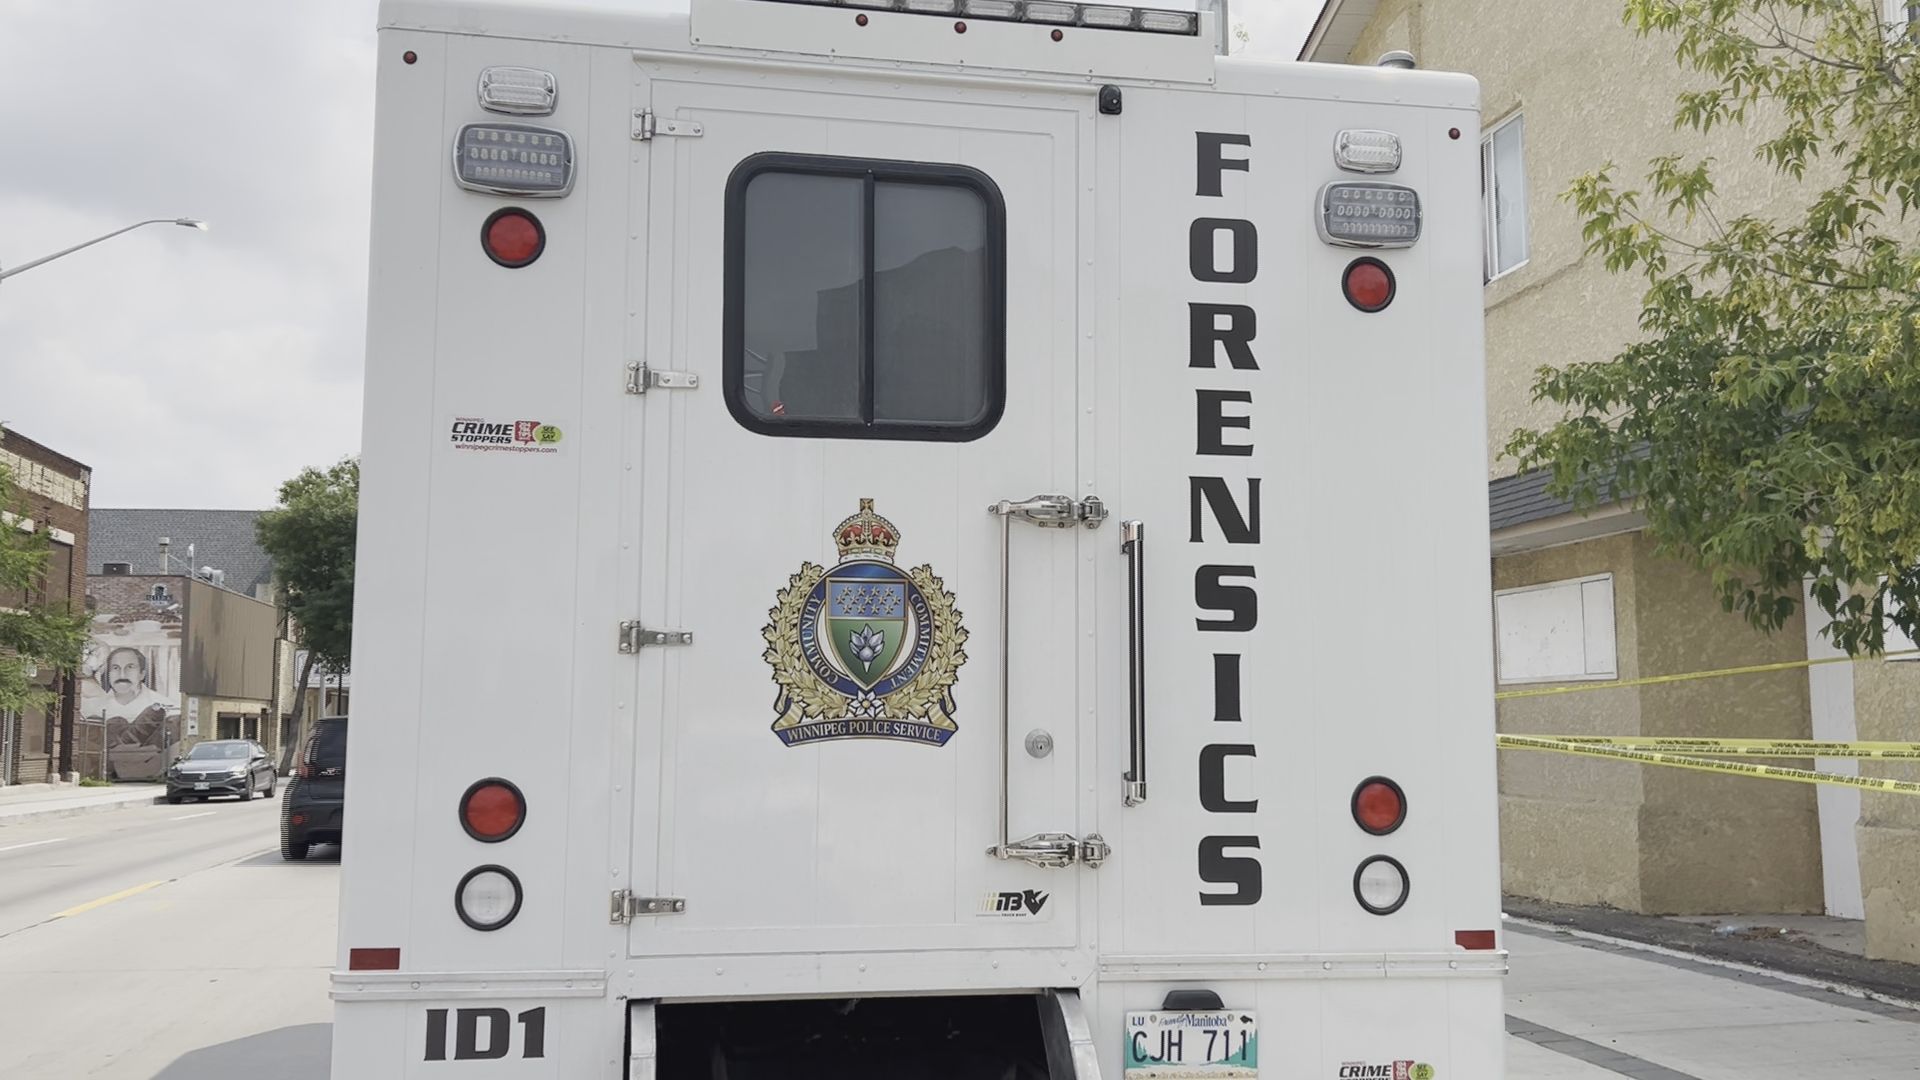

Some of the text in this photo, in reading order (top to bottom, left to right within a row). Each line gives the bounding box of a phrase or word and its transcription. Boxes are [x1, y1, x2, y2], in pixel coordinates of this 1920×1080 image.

[451, 421, 514, 435] CRIME
[450, 434, 512, 444] STOPPERS
[455, 443, 558, 453] winnipegcrimestoppers.com
[1188, 131, 1262, 907] FORENSICS
[802, 593, 839, 684] COMMUNITY
[890, 593, 930, 689] COMMITMENT
[787, 721, 942, 741] WINNIPEG POLICE SERVICE
[1132, 1016, 1145, 1026] LU
[1185, 1014, 1228, 1027] Manitoba
[424, 1007, 546, 1061] ID1
[1132, 1030, 1247, 1062] CJH 711
[1340, 1065, 1392, 1078] CRIME
